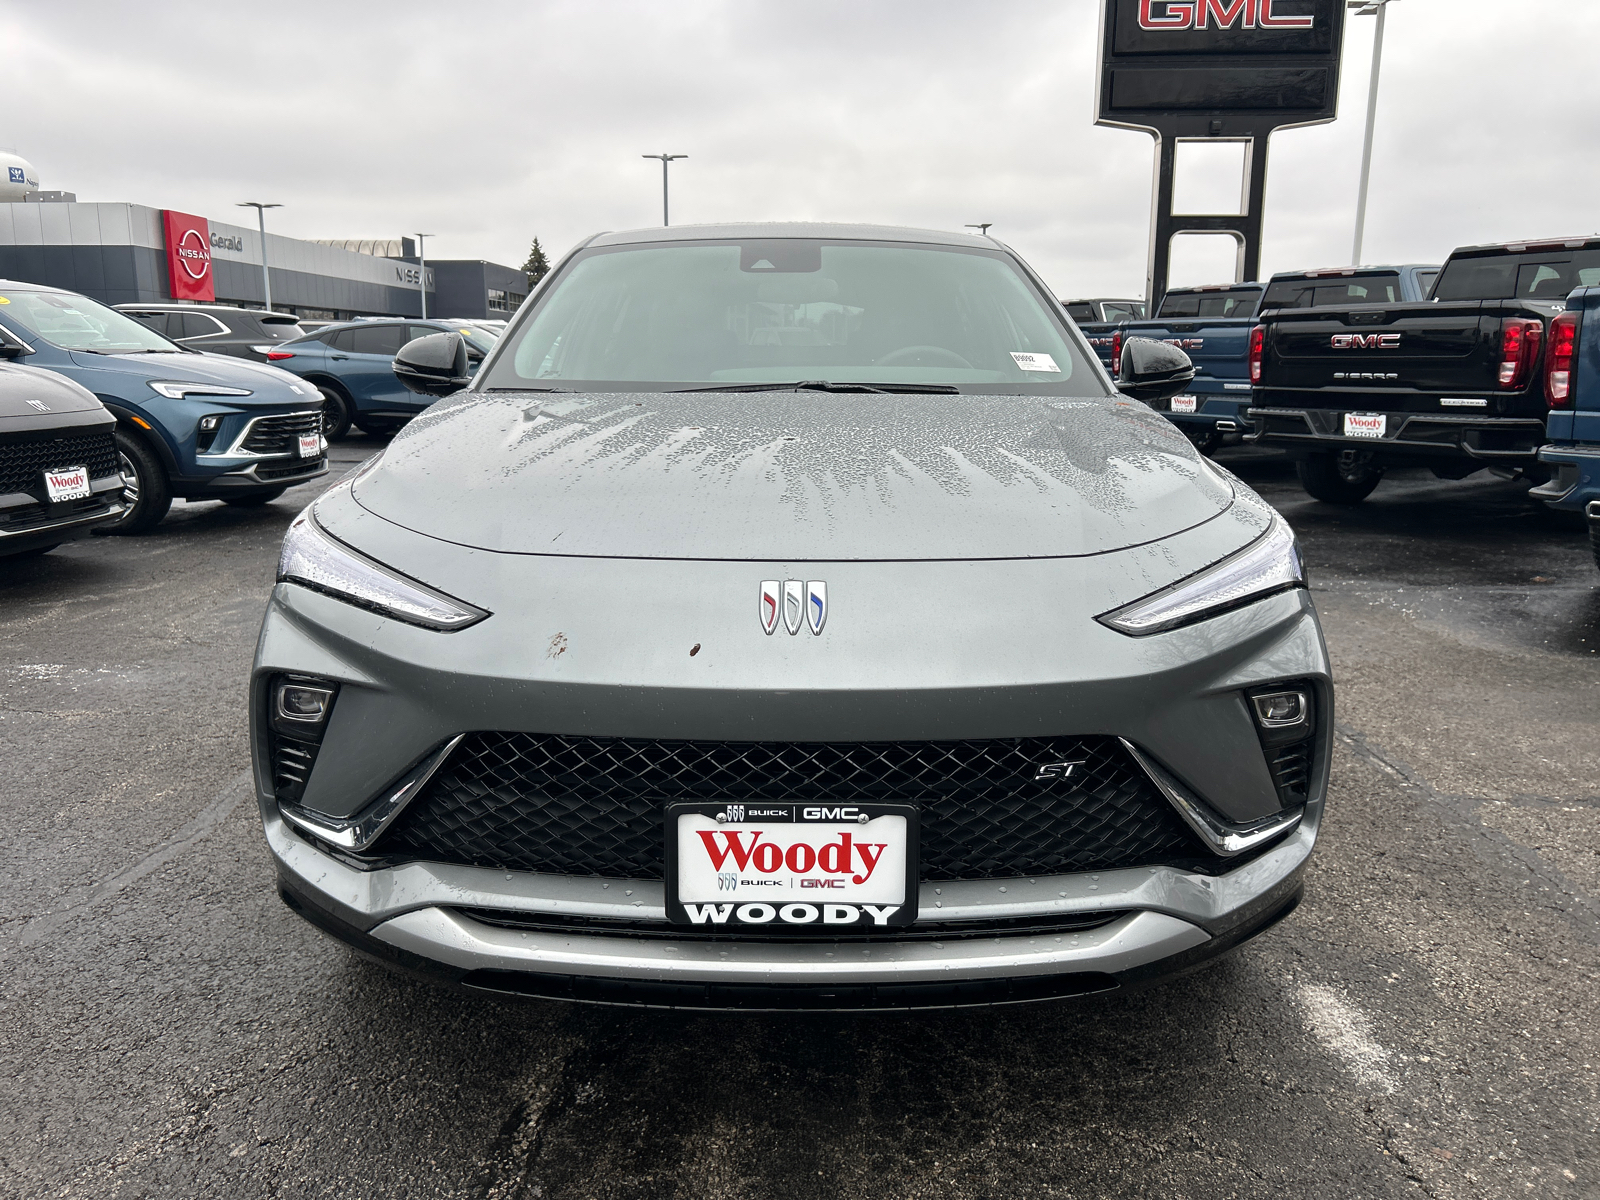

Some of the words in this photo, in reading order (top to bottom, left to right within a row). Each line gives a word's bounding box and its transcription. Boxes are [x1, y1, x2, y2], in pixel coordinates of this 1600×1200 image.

[1138, 0, 1315, 30] GMC
[210, 232, 243, 252] Gerald
[179, 248, 210, 260] NISSAN
[1331, 334, 1401, 348] GMC
[1173, 397, 1194, 407] Woody
[1348, 416, 1383, 430] Woody
[300, 438, 318, 447] Woody
[49, 473, 84, 488] Woody
[51, 490, 91, 503] WOODY
[1035, 760, 1086, 780] ST
[803, 807, 859, 820] GMC
[695, 830, 888, 885] Woody
[800, 878, 845, 888] GMC
[683, 903, 900, 925] WOODY
